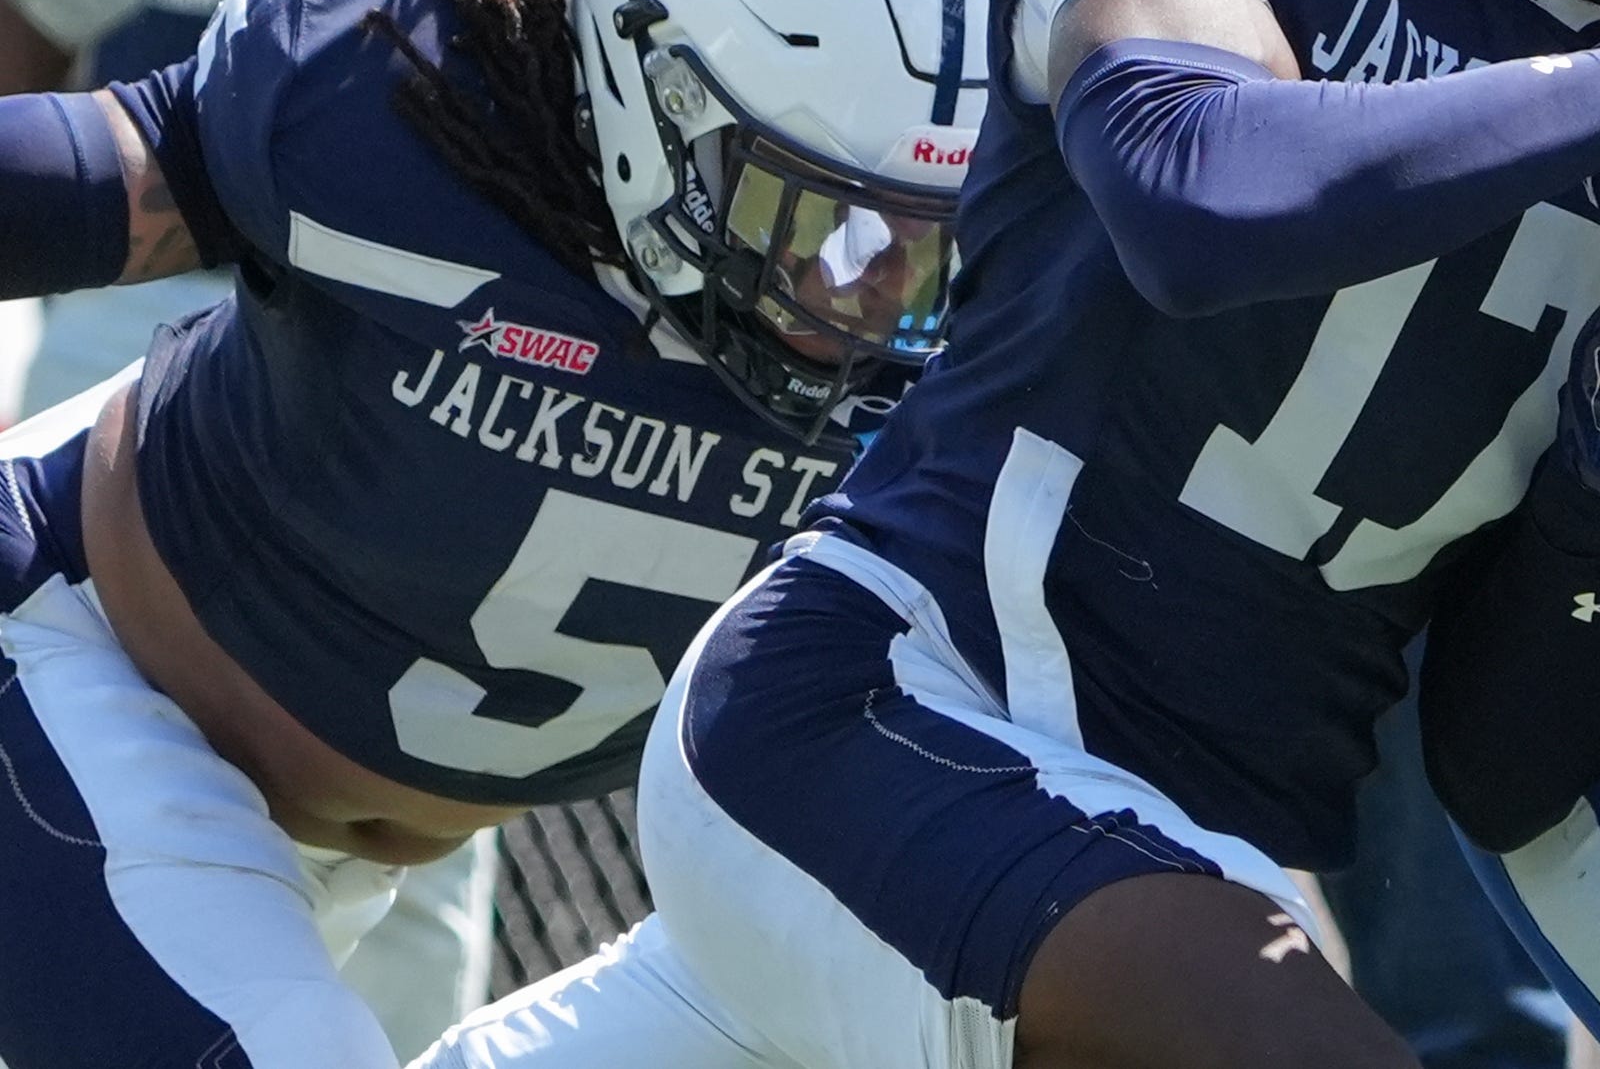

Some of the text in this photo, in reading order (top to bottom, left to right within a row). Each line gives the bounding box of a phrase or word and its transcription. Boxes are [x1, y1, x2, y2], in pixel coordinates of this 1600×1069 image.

[391, 349, 837, 529] JACKSON ST
[498, 327, 597, 372] SWAC
[388, 488, 759, 779] 5
